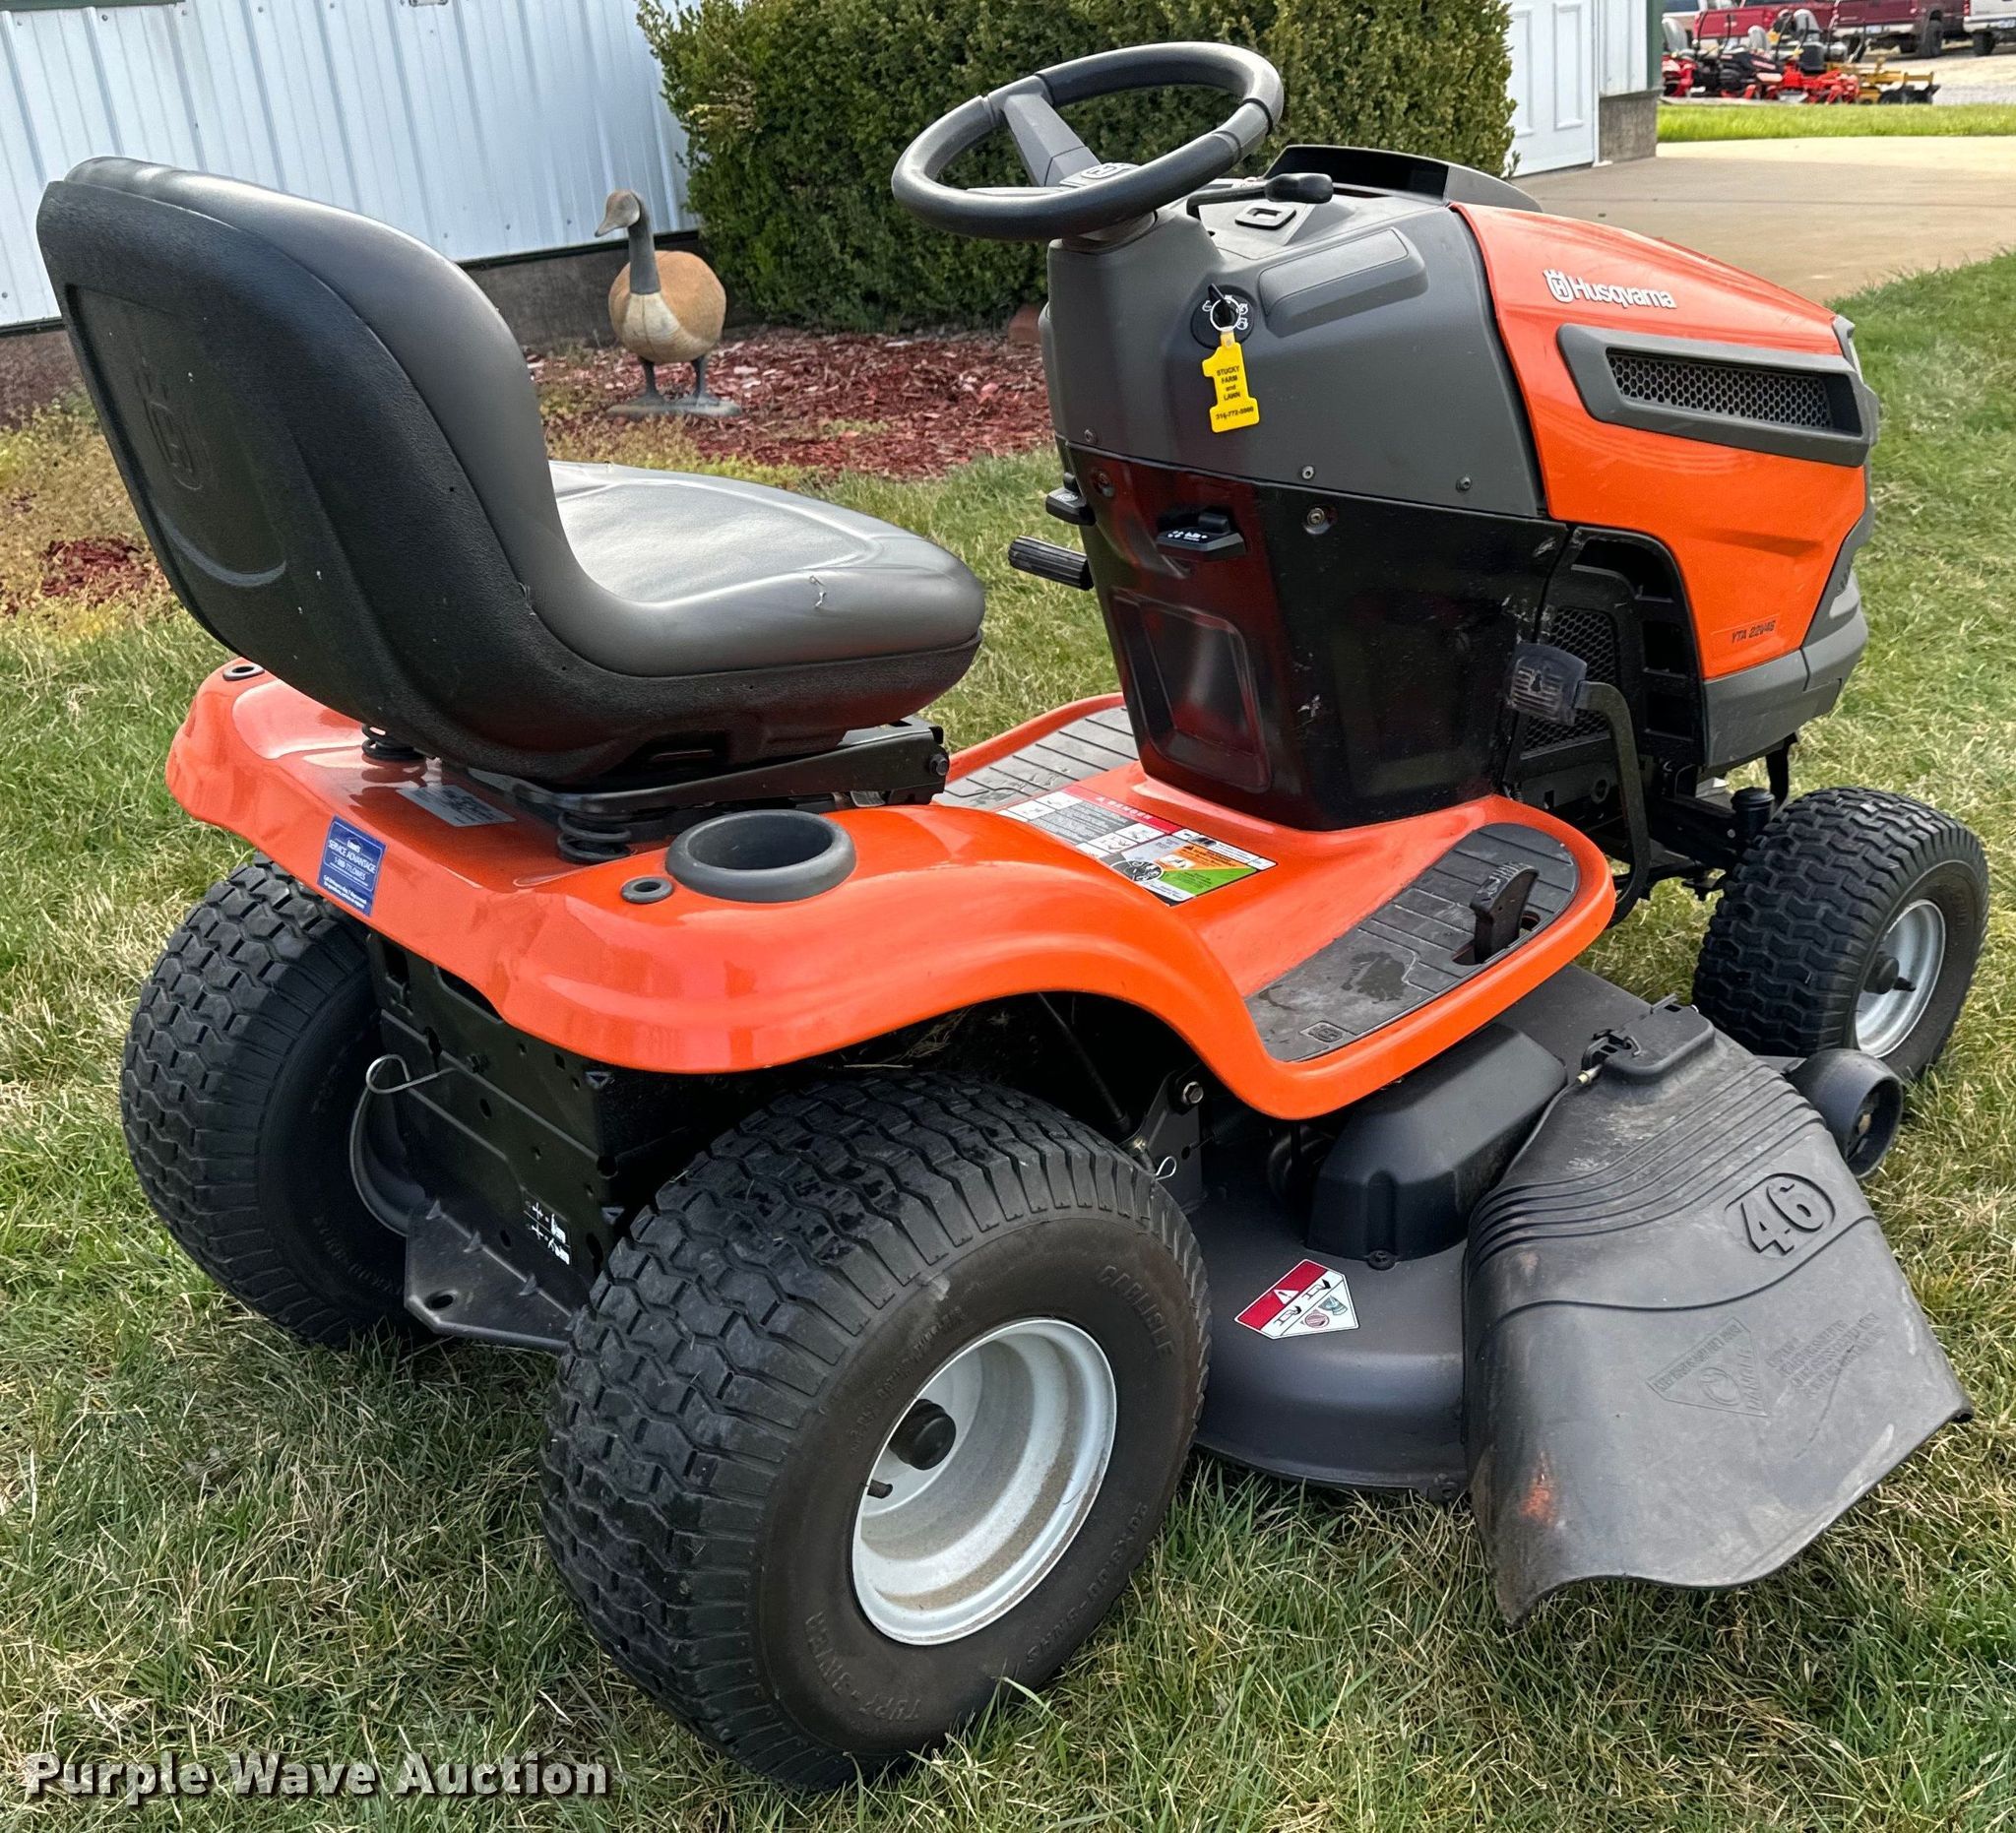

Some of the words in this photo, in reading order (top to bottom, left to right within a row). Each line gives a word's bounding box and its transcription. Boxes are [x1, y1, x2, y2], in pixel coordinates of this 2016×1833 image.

[1569, 276, 1677, 310] Husqvarna
[1217, 365, 1240, 377] STUCKY
[1221, 375, 1238, 385] FARM
[1224, 392, 1241, 401] LAWN
[1738, 1183, 1825, 1256] 46
